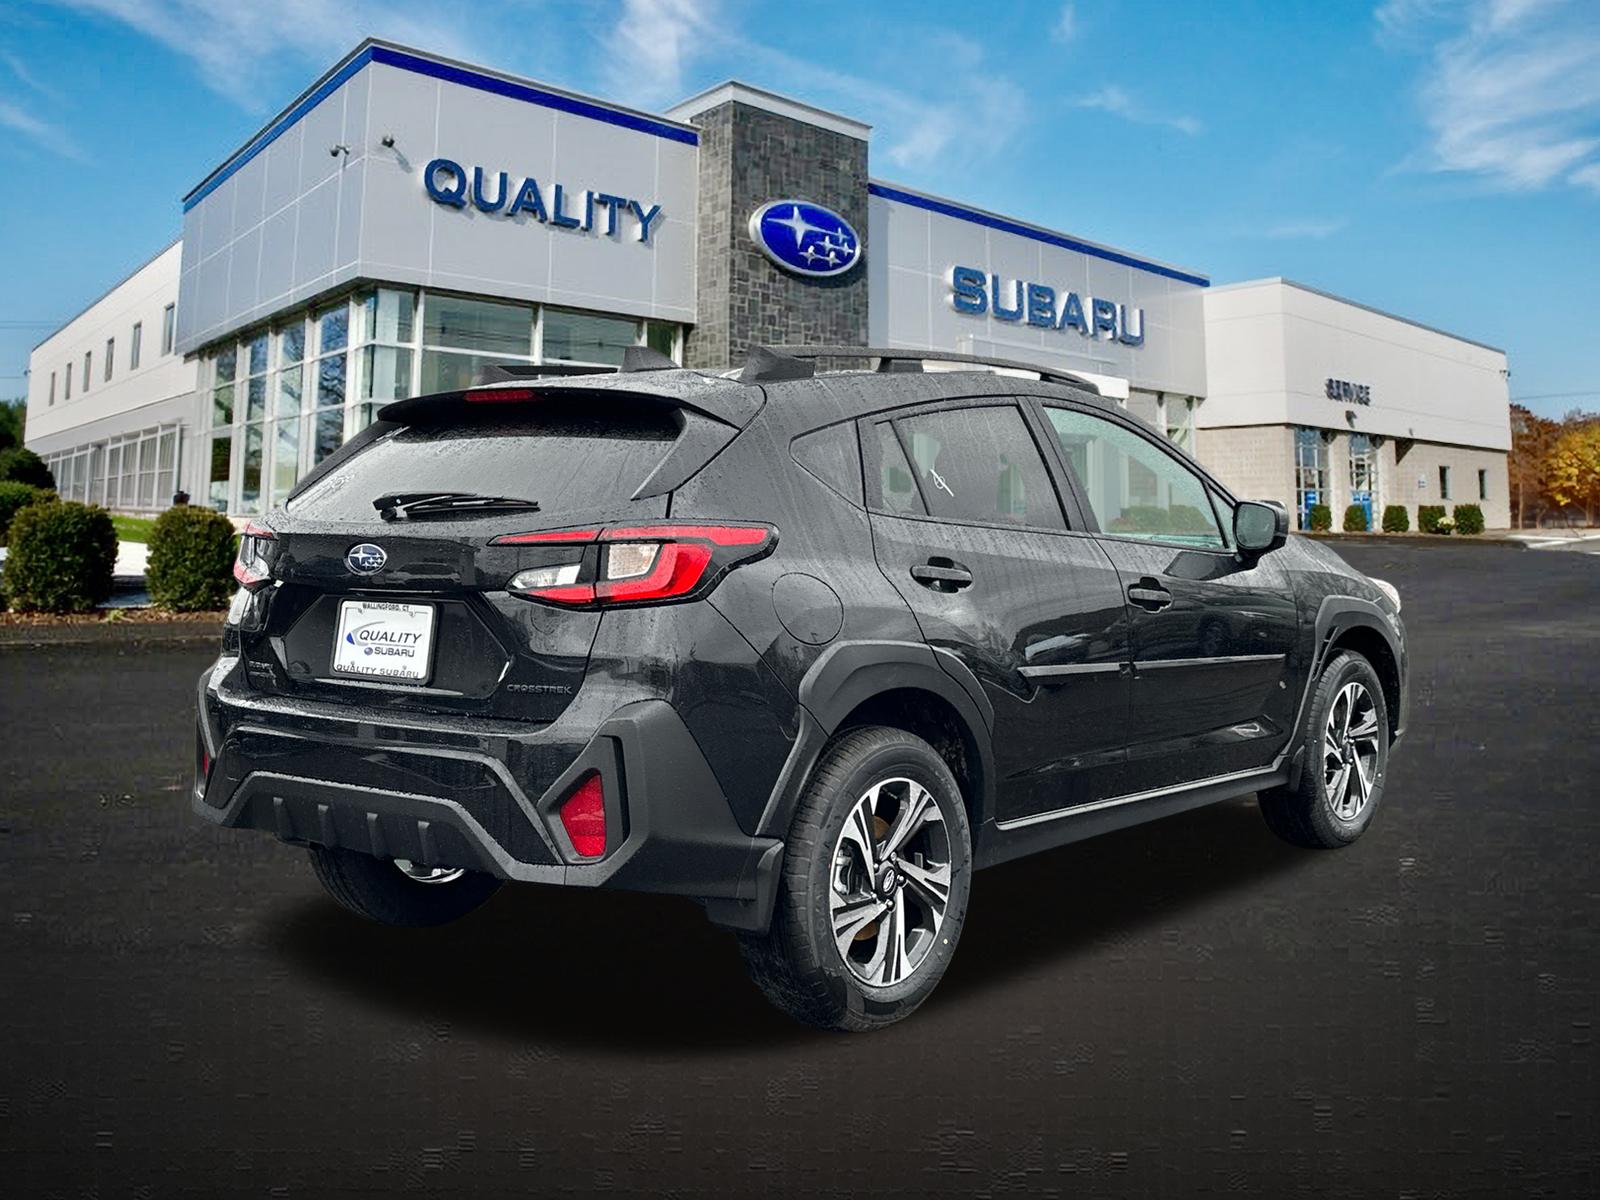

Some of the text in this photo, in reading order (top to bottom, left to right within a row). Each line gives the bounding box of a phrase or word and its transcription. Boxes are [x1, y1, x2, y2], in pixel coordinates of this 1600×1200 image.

[424, 158, 662, 243] QUALITY
[952, 265, 1145, 347] SUBARU
[1325, 377, 1371, 407] SERVICE
[359, 629, 422, 644] QUALITY
[374, 646, 415, 658] SUBARU
[336, 663, 419, 678] QUALITY SUBARU
[506, 683, 573, 695] CROSSTREK
